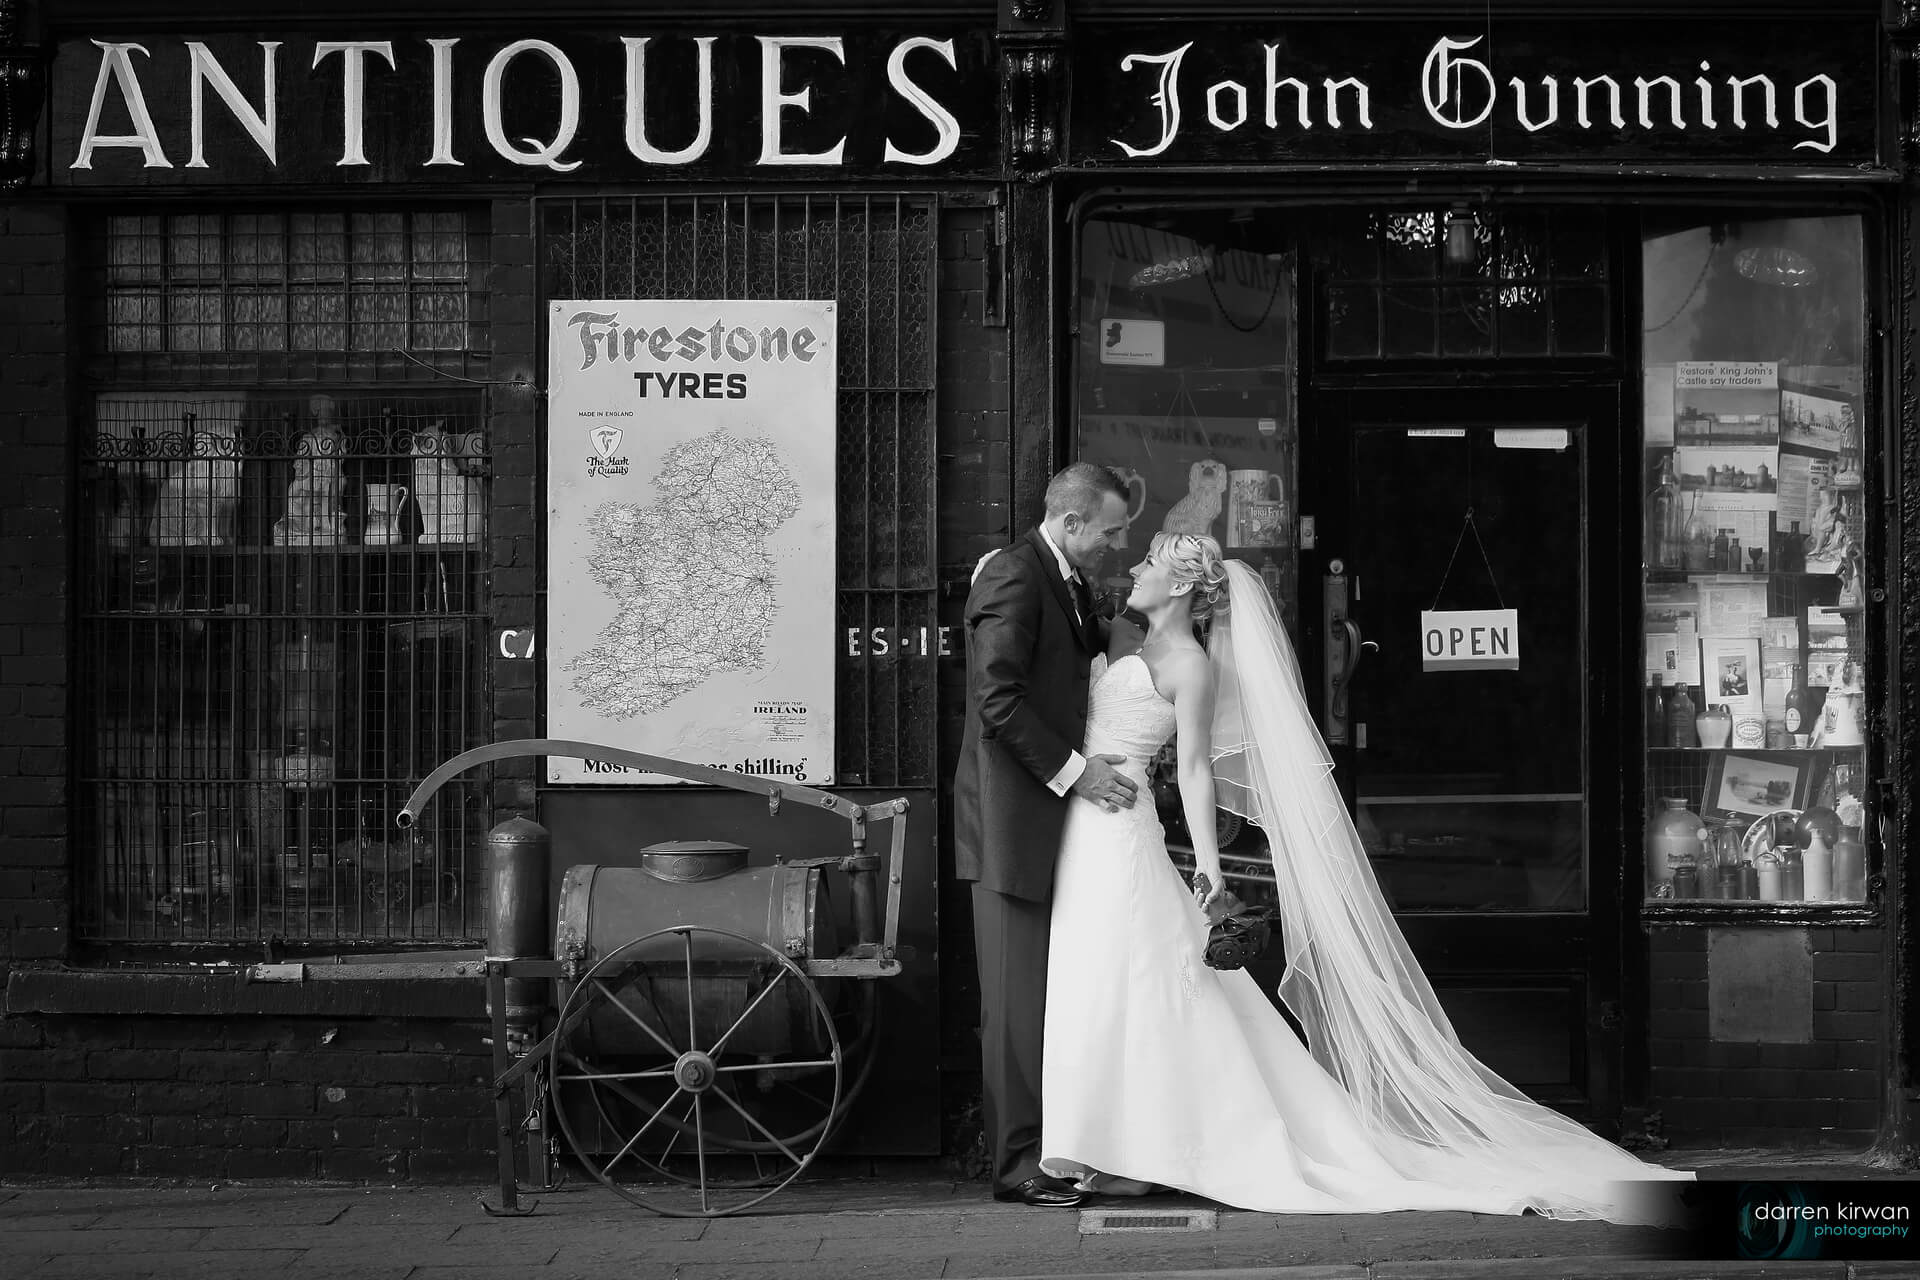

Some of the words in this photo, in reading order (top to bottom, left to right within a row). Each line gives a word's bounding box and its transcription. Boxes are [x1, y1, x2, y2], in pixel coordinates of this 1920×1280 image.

[70, 36, 961, 172] ANTIQUES
[1110, 40, 1373, 158] John
[1422, 35, 1838, 153] Gunning
[567, 311, 818, 370] Firestone
[1678, 376, 1706, 385] Castle
[1709, 378, 1726, 386] say
[1729, 376, 1762, 385] traders
[1720, 367, 1741, 377] King
[1743, 367, 1773, 376] John's
[634, 372, 747, 399] TYRES
[586, 456, 605, 467] The
[605, 456, 630, 467] Mark
[587, 466, 598, 478] of
[597, 466, 629, 478] Quality
[1426, 627, 1509, 656] OPEN
[753, 706, 807, 714] IRELAND
